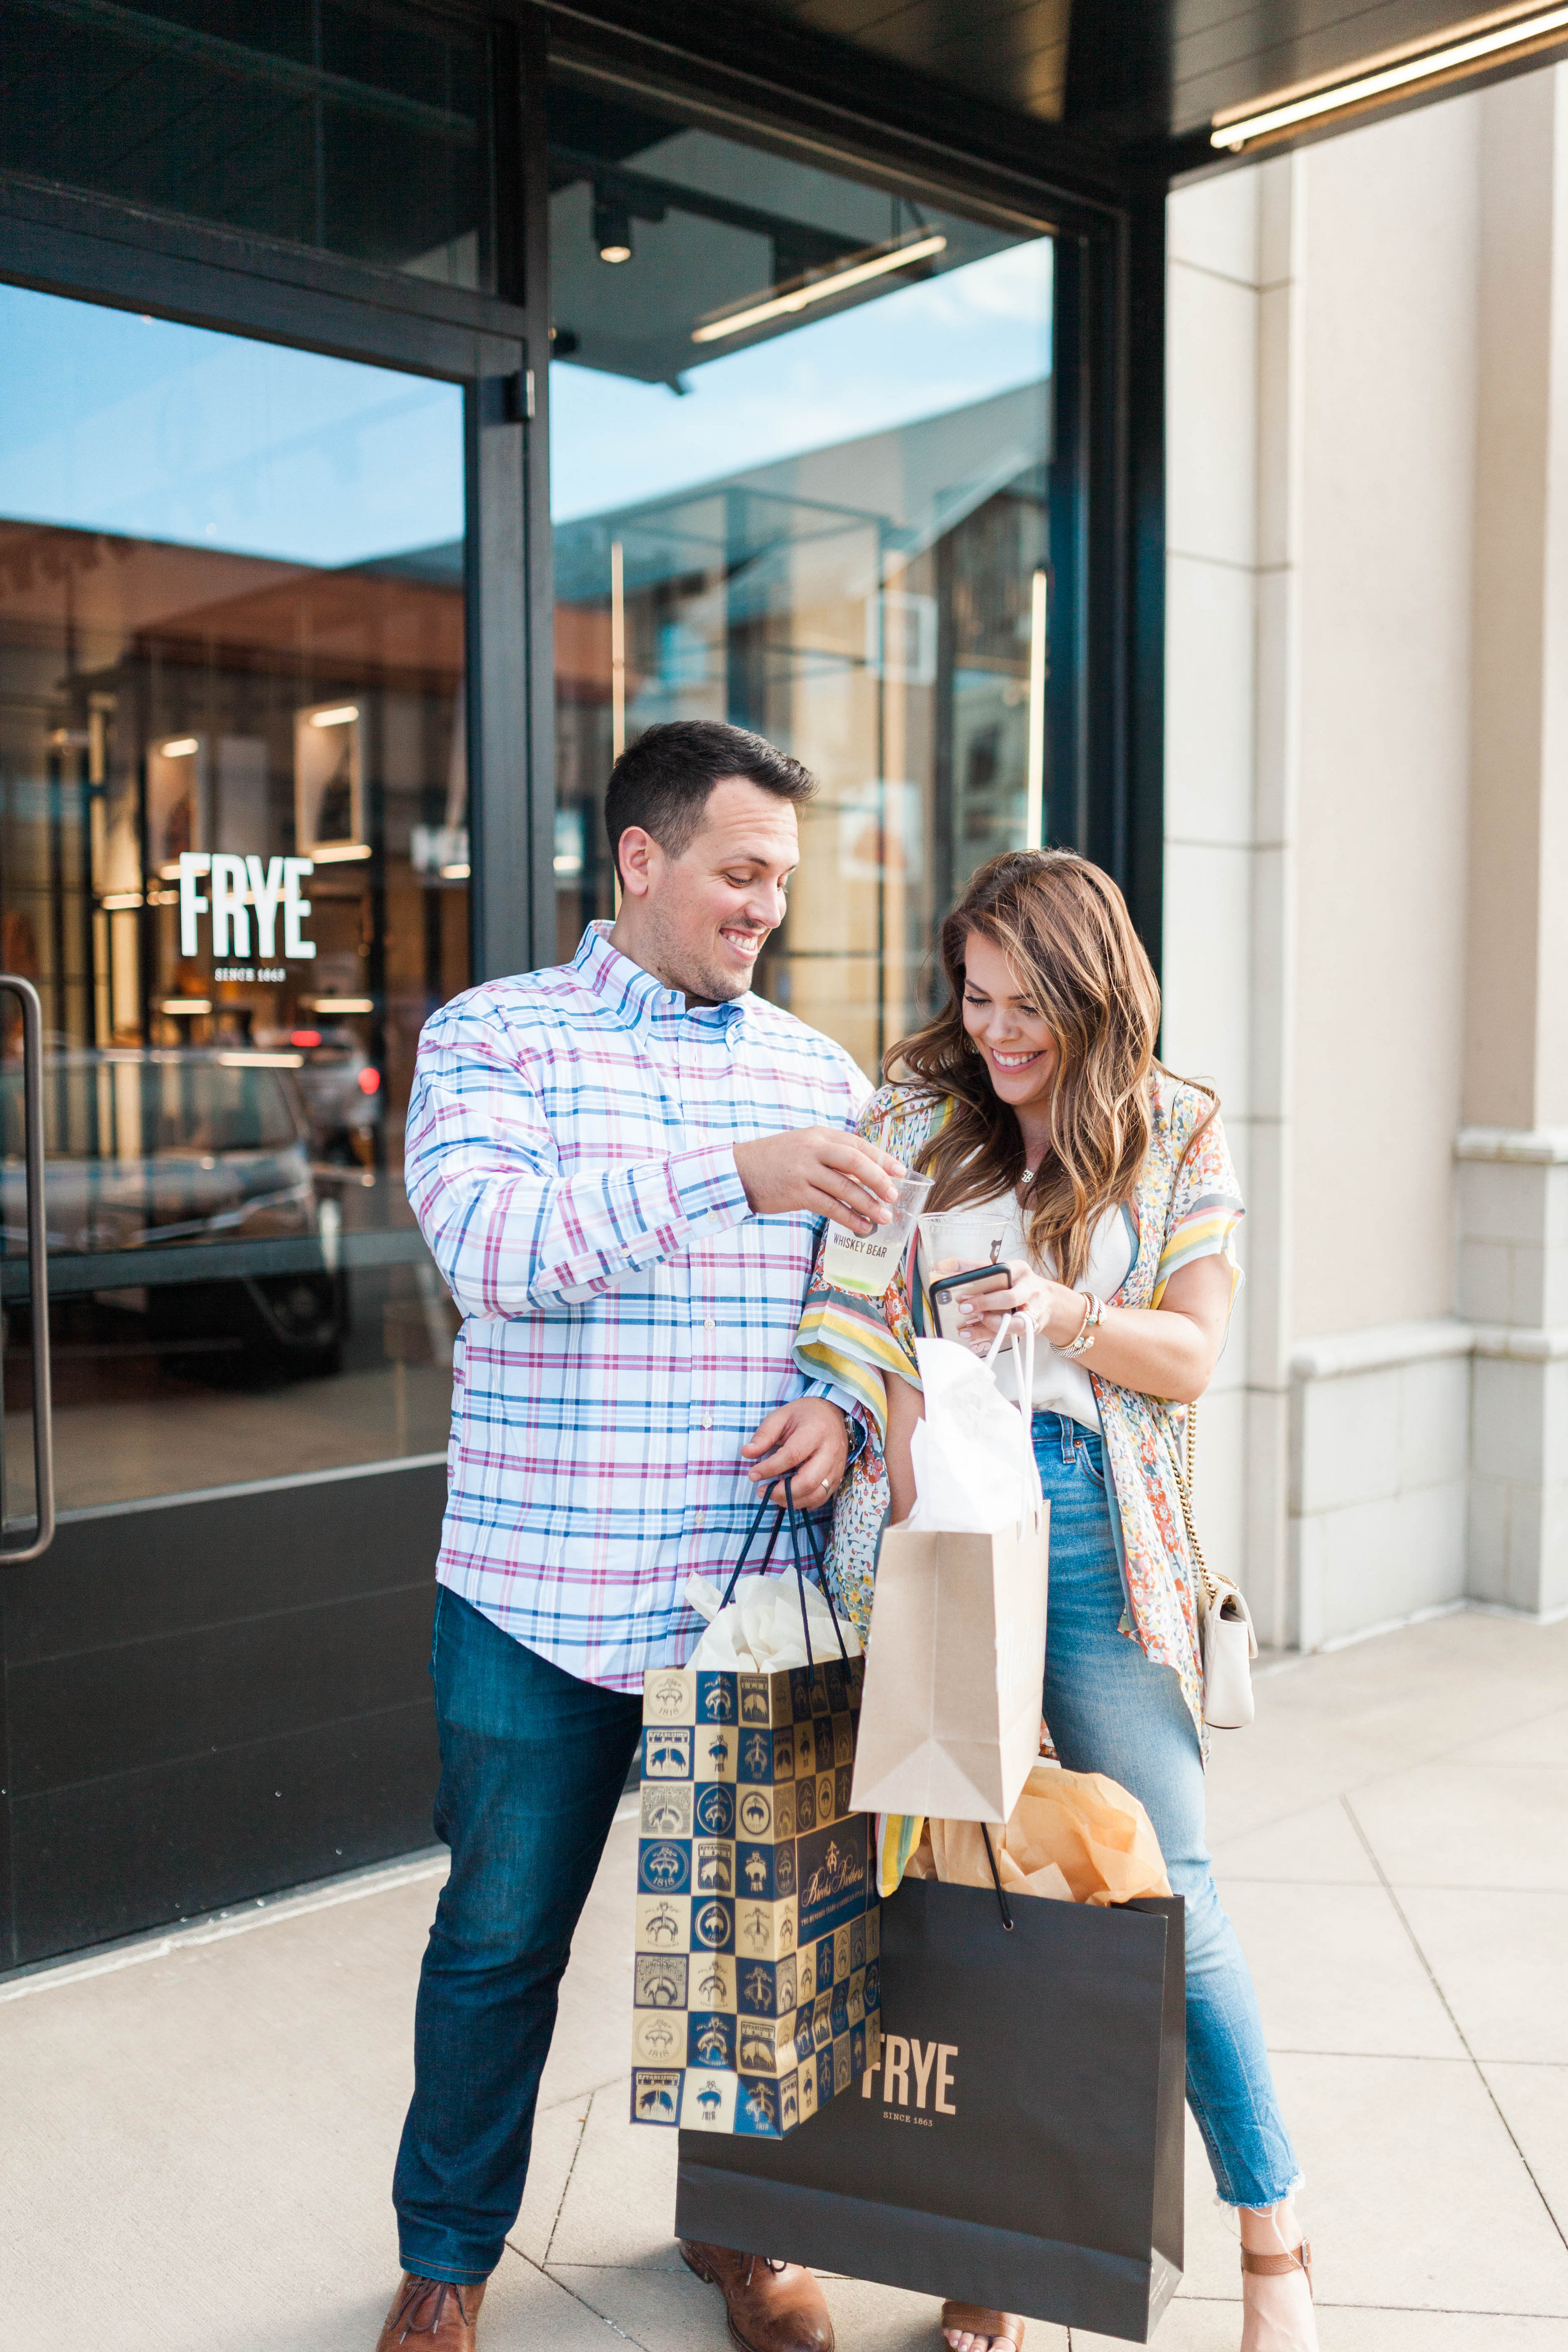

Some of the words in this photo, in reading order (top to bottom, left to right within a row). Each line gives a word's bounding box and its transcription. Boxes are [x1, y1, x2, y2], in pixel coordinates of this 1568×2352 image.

[180, 852, 316, 958] FRYE
[215, 968, 255, 981] SINCE
[834, 1232, 865, 1252] WHISKEY
[866, 1244, 887, 1258] BEAR
[659, 1708, 679, 1716] 1818
[653, 1877, 674, 1887] 1818
[801, 1867, 831, 1907] Brooks
[831, 1854, 864, 1893] Brothers
[751, 1882, 763, 1892] 1818
[648, 2050, 669, 2058] 1818
[702, 2112, 716, 2121] 1818
[883, 2112, 911, 2123] SINCE
[913, 2117, 933, 2127] 1863
